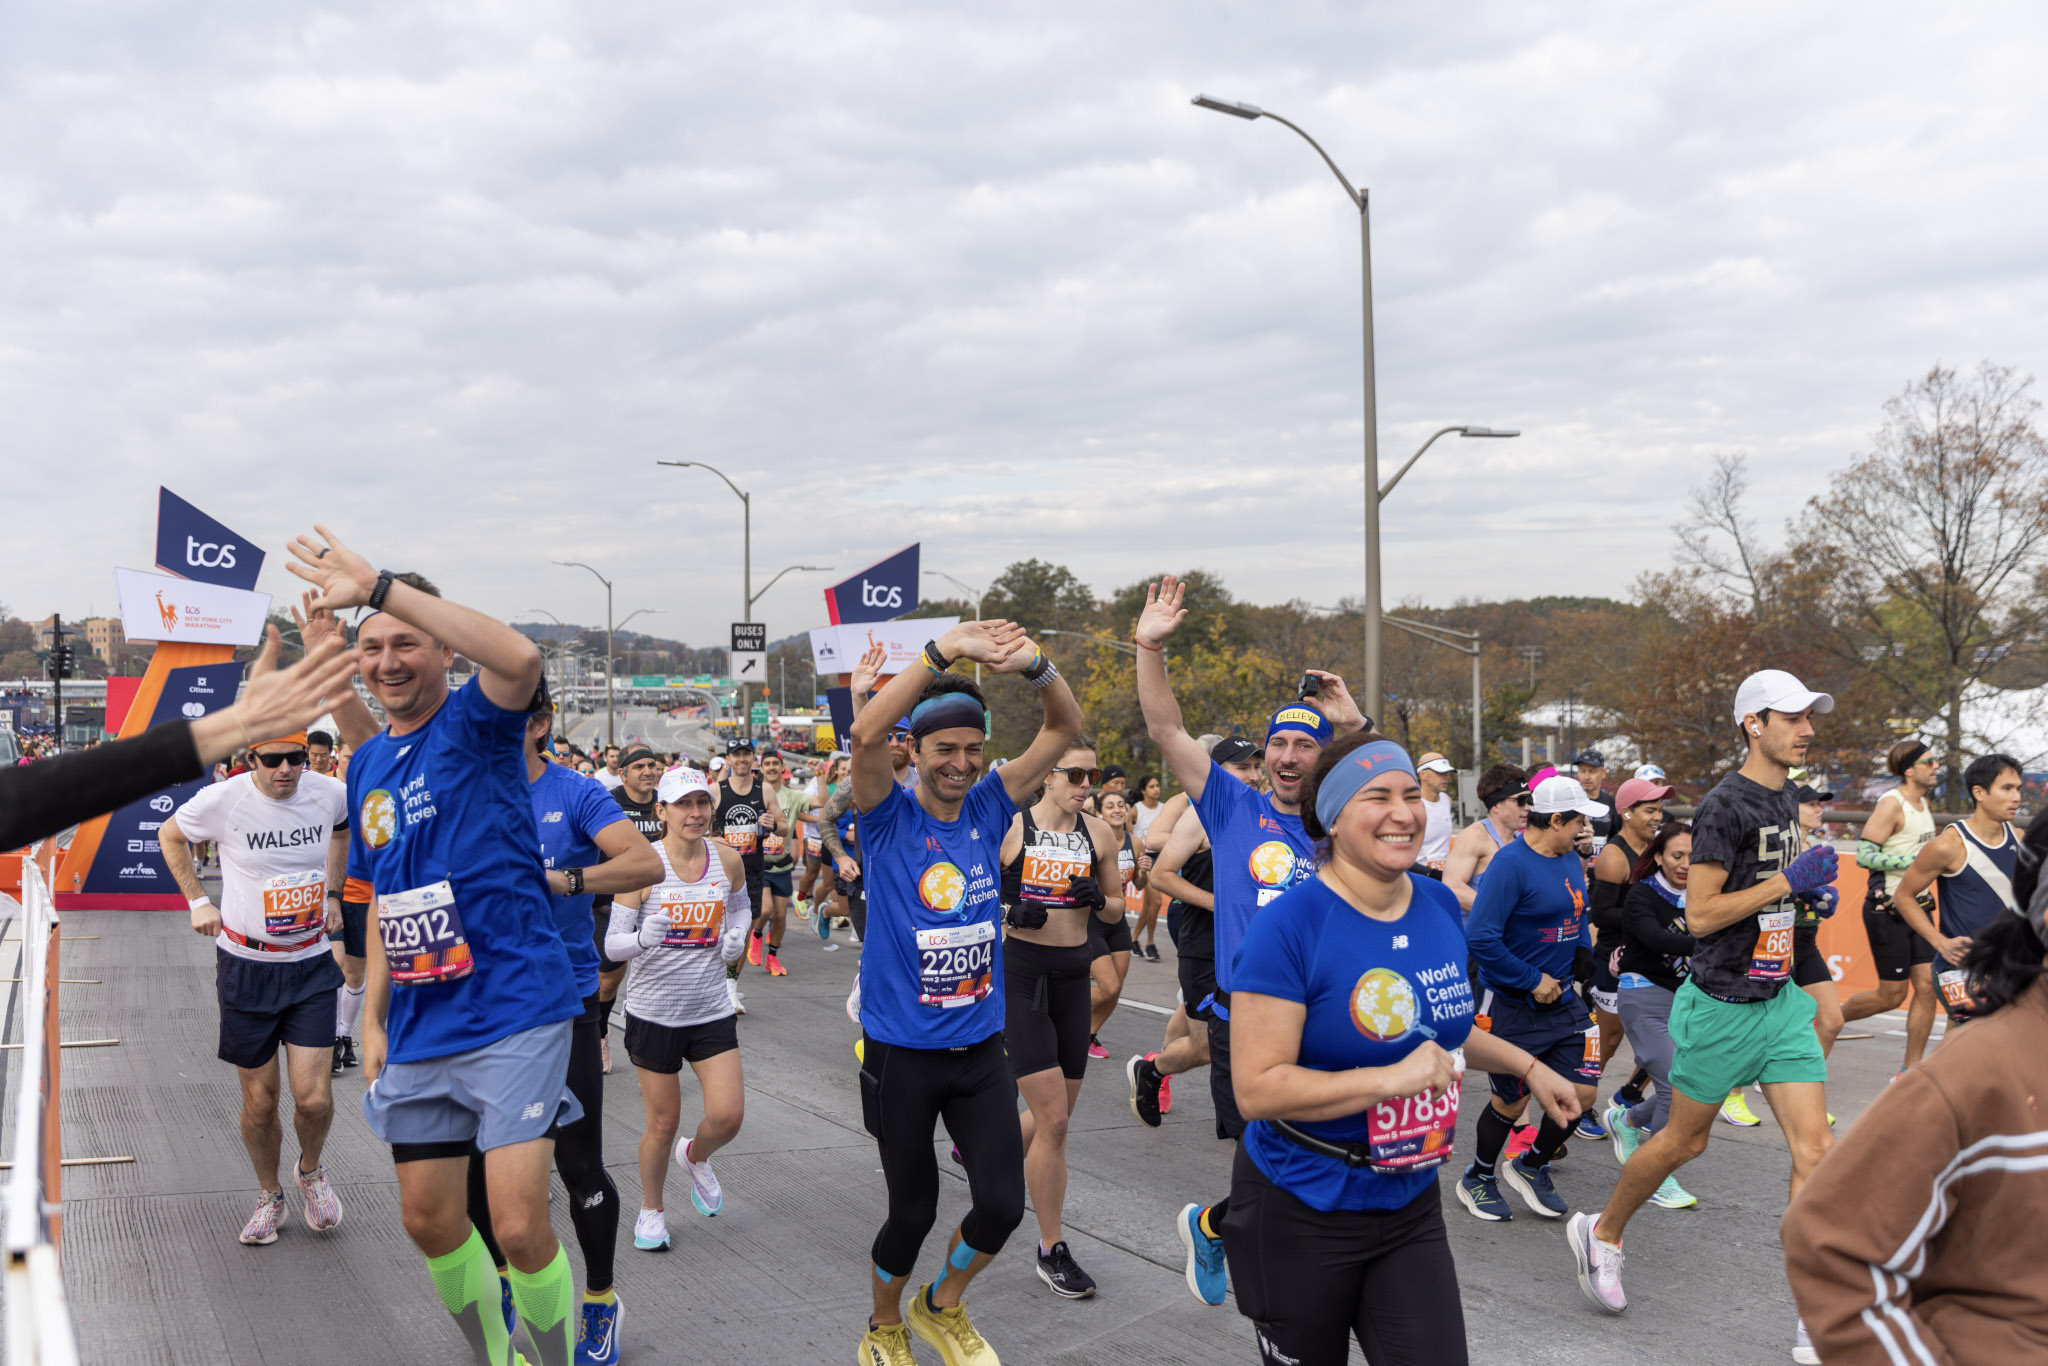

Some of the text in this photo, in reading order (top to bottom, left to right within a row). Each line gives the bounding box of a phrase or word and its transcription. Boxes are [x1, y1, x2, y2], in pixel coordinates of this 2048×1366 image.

[186, 535, 236, 569] tcs
[862, 579, 902, 608] tcs
[185, 605, 201, 614] tcs
[734, 625, 764, 636] BUSES
[736, 639, 761, 650] ONLY
[189, 686, 214, 694] Citizens
[1280, 711, 1319, 726] BELIEVE
[139, 822, 163, 831] ESP
[735, 815, 748, 825] W
[247, 825, 323, 850] WALSHY
[728, 832, 756, 844] 12647
[1030, 859, 1086, 883] 12847
[269, 884, 321, 911] 12962
[672, 903, 716, 924] 8707
[380, 909, 455, 948] 22912
[929, 935, 948, 945] tcs
[922, 942, 992, 975] 22604
[1416, 961, 1460, 987] World
[1372, 1133, 1391, 1141] WAVE
[1391, 1130, 1397, 1139] 5
[1433, 1120, 1440, 1129] C
